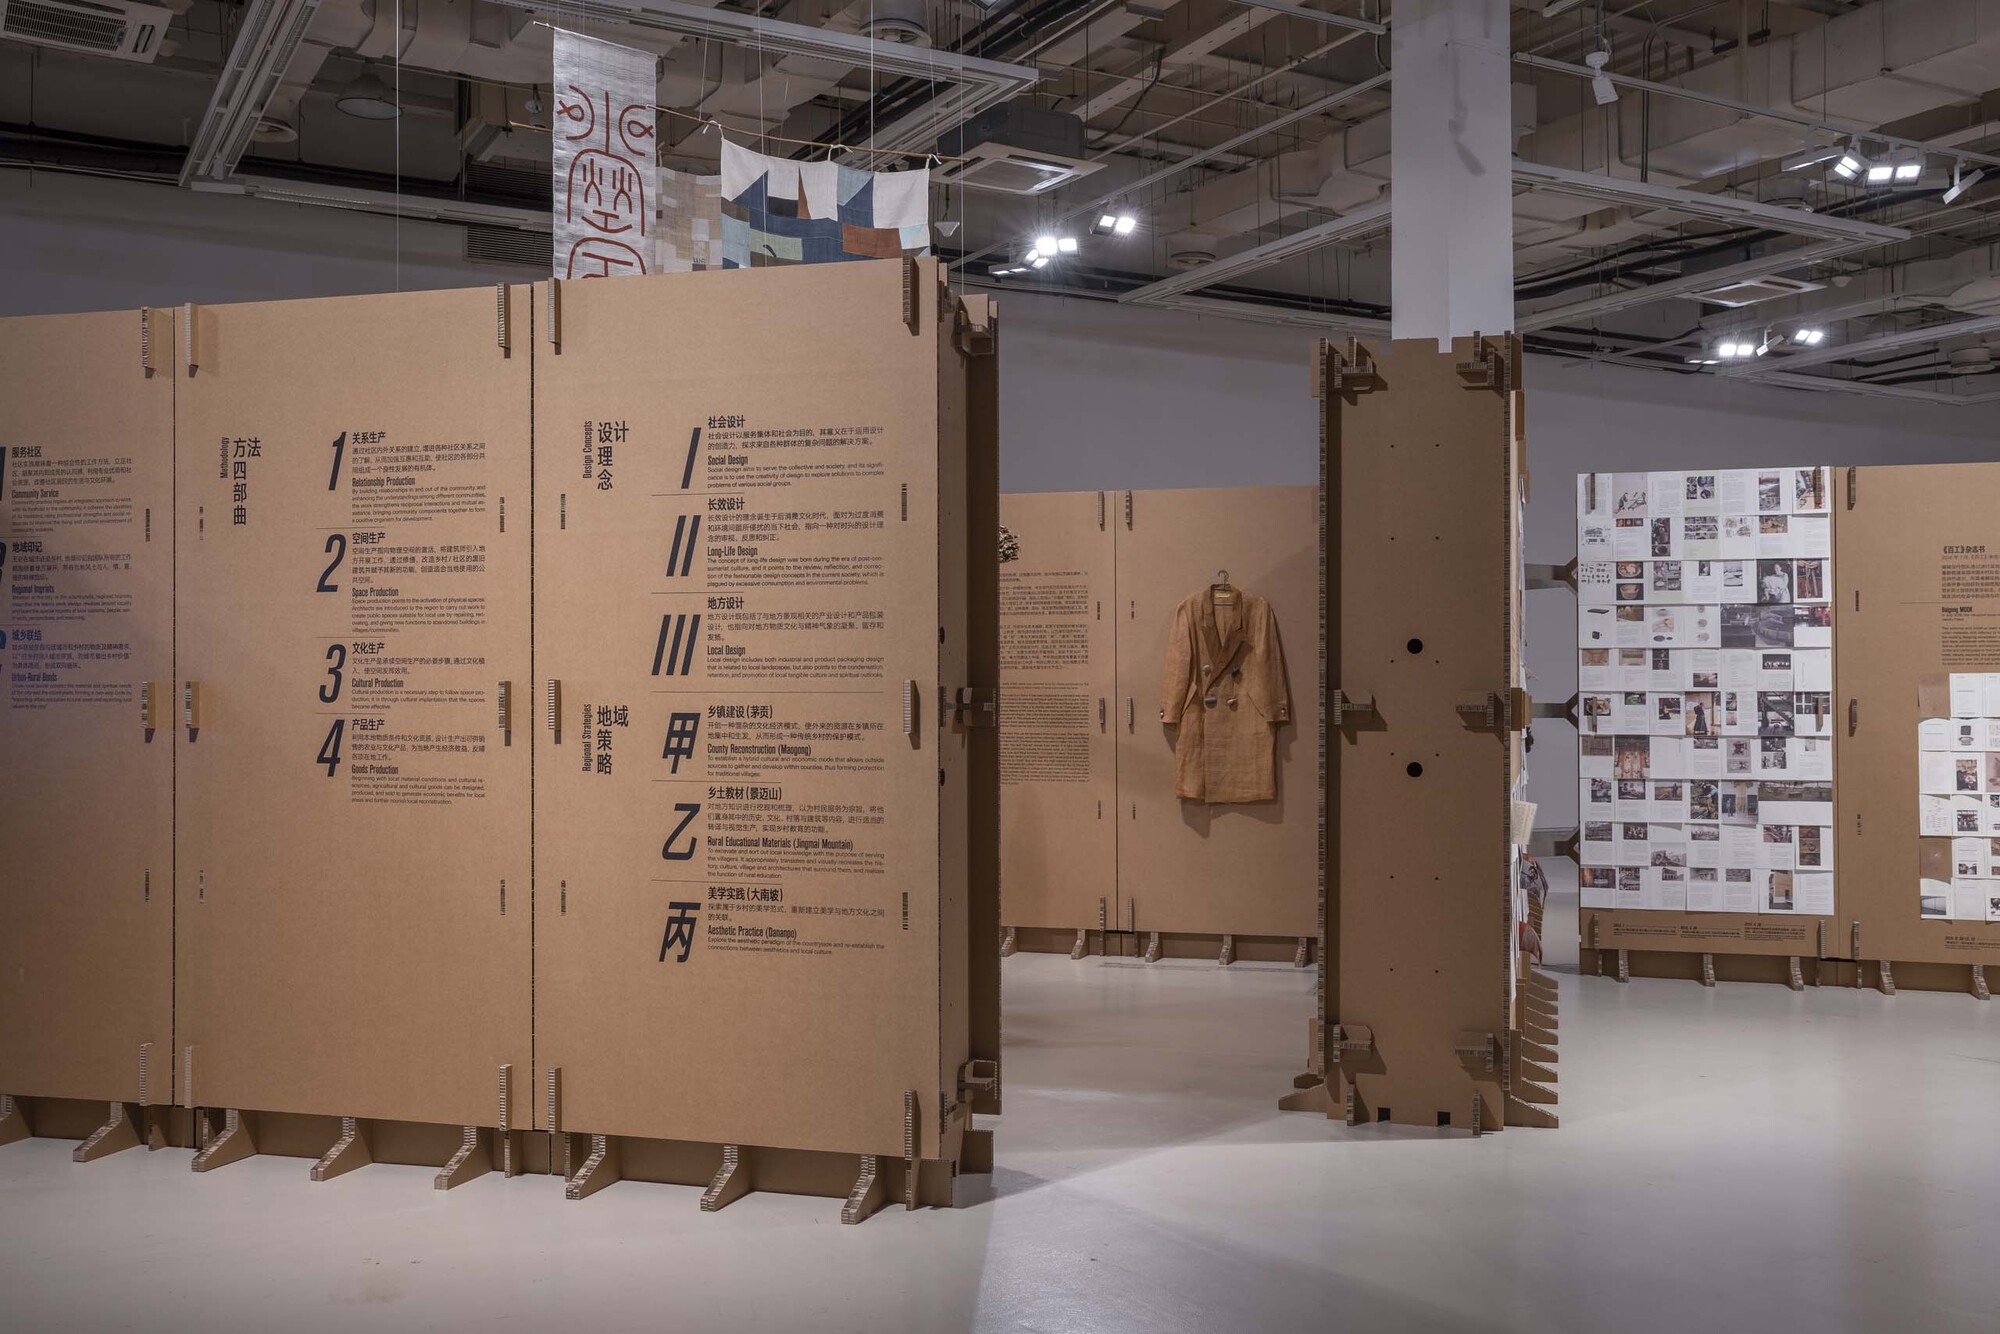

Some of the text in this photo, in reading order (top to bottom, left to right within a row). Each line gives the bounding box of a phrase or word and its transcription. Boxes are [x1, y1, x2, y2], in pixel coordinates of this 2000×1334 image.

[708, 415, 746, 429] 社会设计
[352, 431, 386, 445] 关系生产
[582, 420, 593, 479] Design Concepts
[220, 436, 230, 479] Methodology
[328, 431, 347, 491] 1
[708, 455, 748, 466] Social Design
[352, 476, 415, 487] Relationship Production
[11, 489, 59, 499] Community Service
[708, 498, 745, 511] 长效设计
[352, 532, 386, 545] 空间生产
[707, 546, 758, 558] Long-Life Design
[316, 533, 347, 593] 2
[352, 587, 399, 598] Space Production
[707, 596, 744, 610] 地方设计
[352, 641, 384, 655] 文化生产
[707, 645, 745, 656] Local Design
[319, 643, 346, 704] 3
[352, 678, 404, 688] Cultural Production
[352, 718, 384, 731] 产品生产
[582, 704, 592, 773] Regional Strategies
[662, 712, 701, 774] 甲
[316, 719, 345, 777] 4
[708, 744, 811, 756] County Reconstruction (Maogong)
[352, 764, 399, 774] Goods Production
[662, 803, 701, 861] 乙
[708, 836, 853, 851] Rural Educational Materials (Jingmai Mountain)
[659, 902, 702, 963] 丙
[708, 925, 797, 940] Aesthetic Practice (Dananpo)
